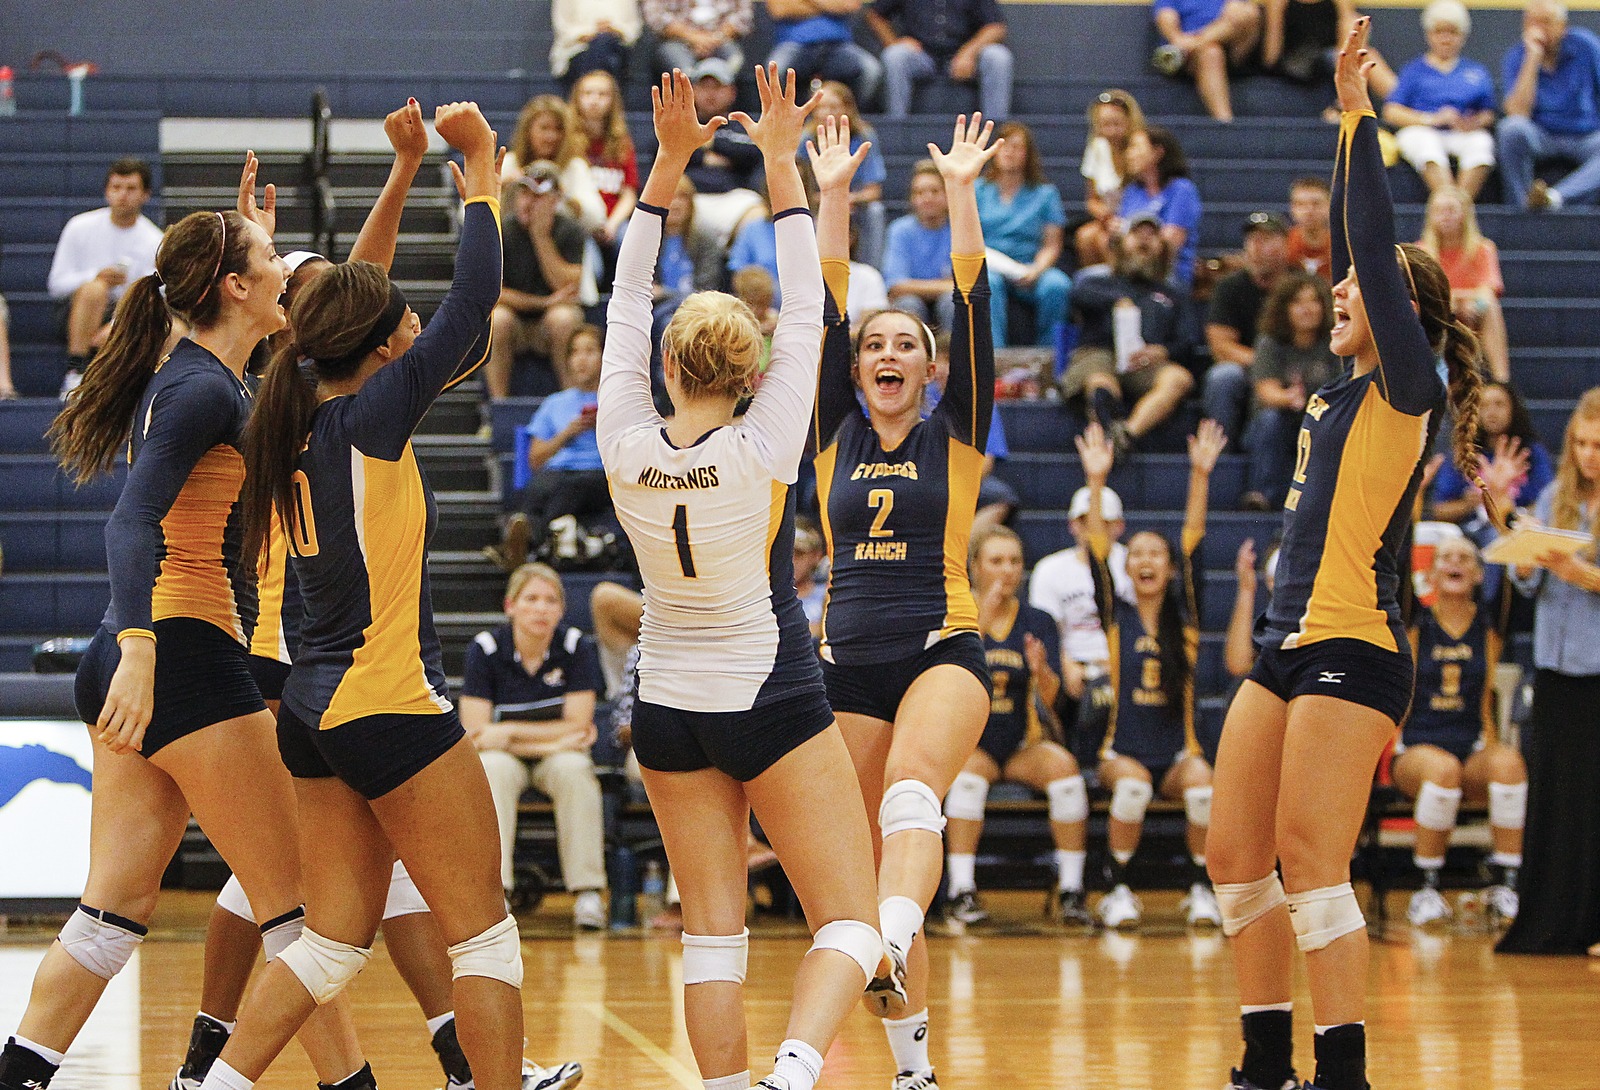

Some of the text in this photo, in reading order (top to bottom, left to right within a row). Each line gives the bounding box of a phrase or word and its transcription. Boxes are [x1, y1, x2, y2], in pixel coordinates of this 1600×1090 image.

[867, 488, 894, 538] 2
[671, 503, 698, 579] 1
[854, 541, 908, 561] RANCH
